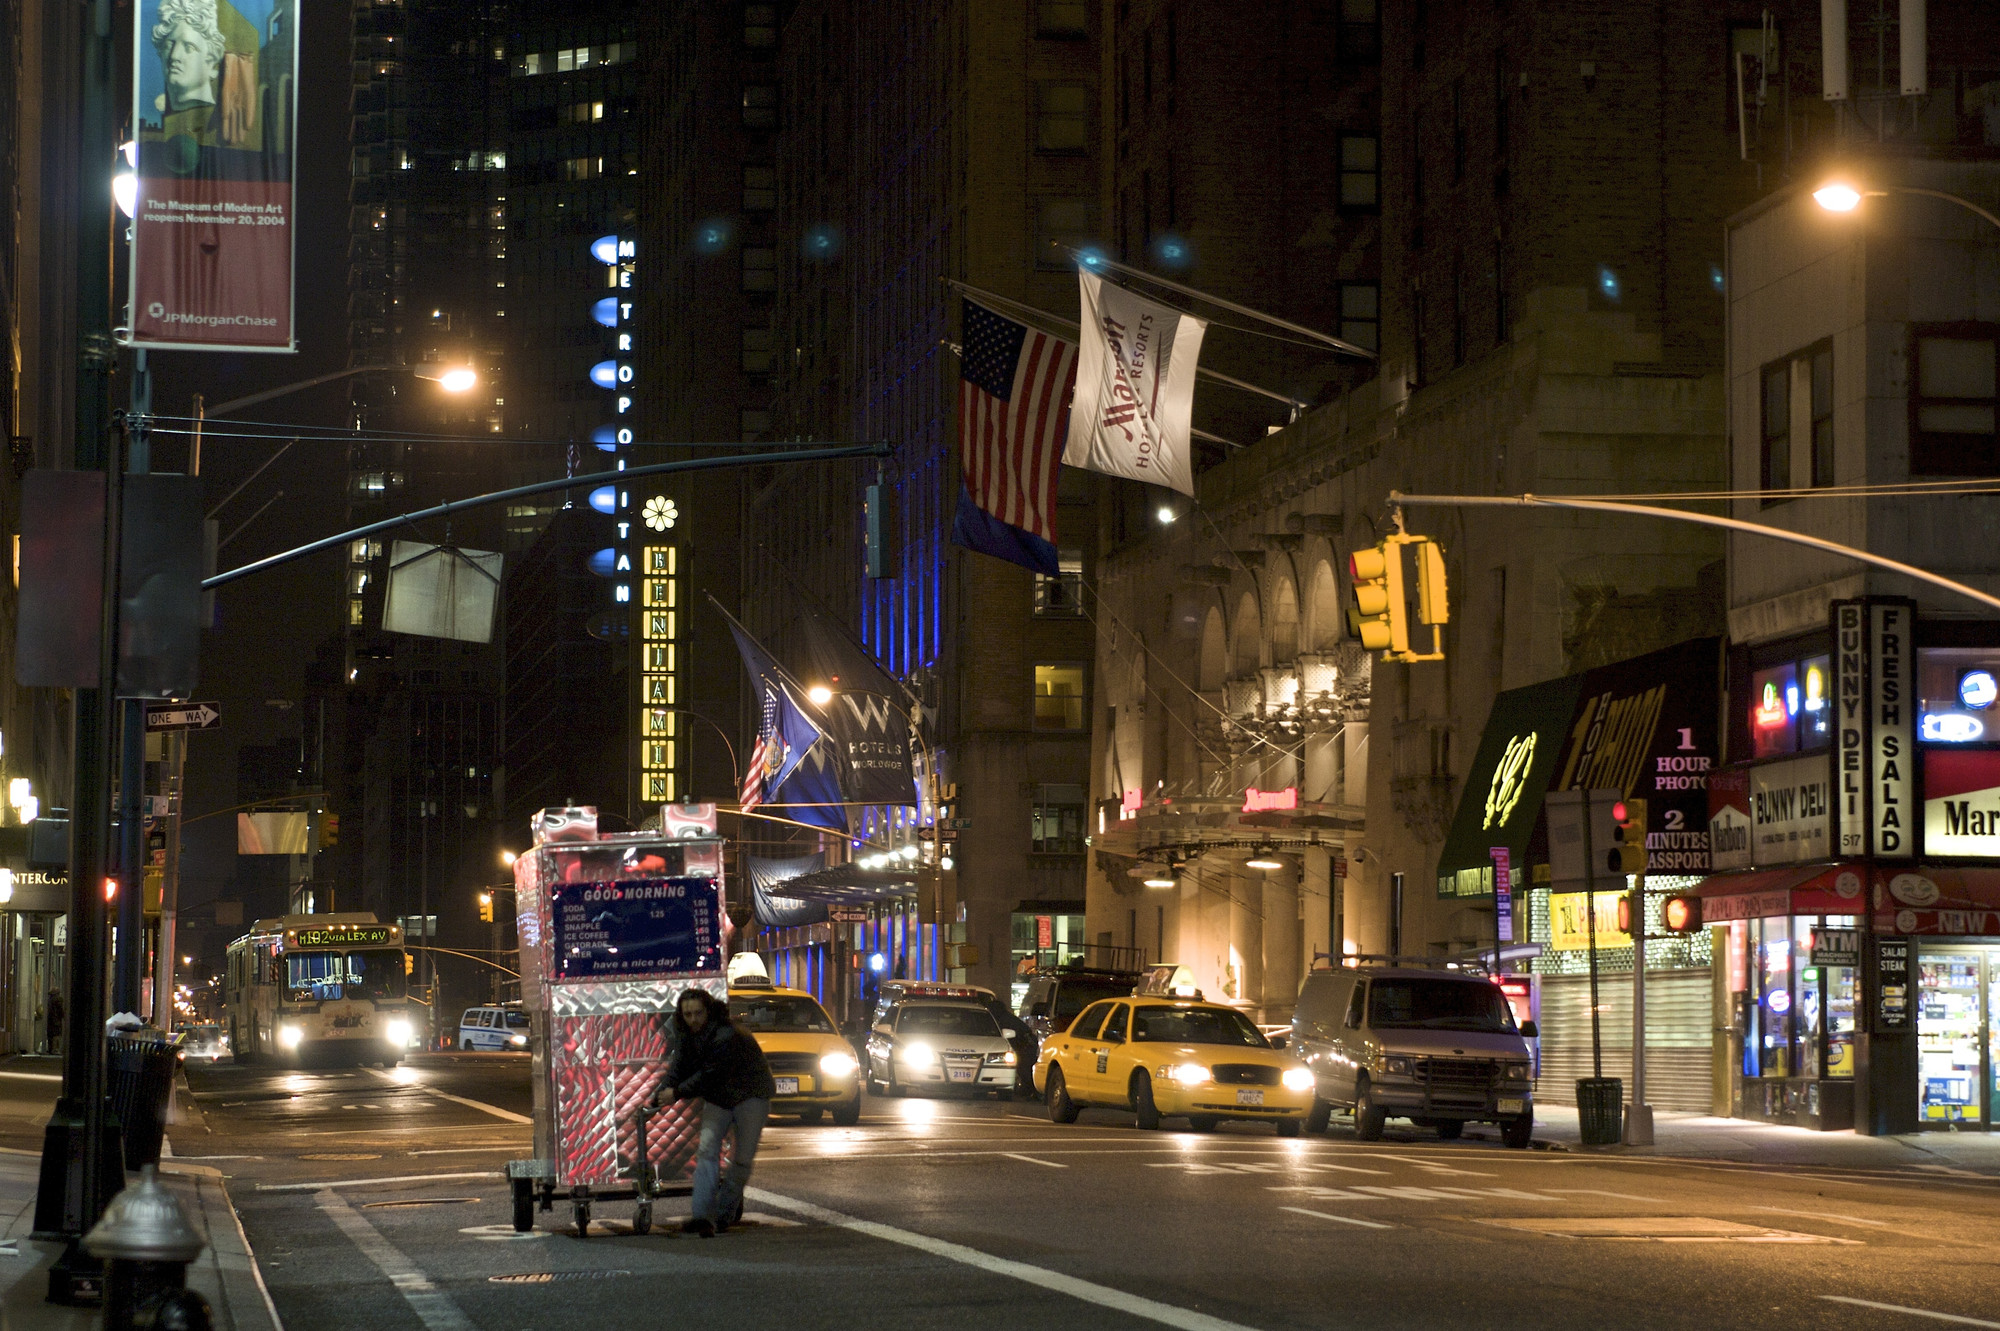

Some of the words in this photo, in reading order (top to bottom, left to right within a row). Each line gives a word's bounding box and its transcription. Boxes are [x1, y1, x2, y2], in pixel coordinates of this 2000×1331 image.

[148, 200, 166, 210] The
[168, 201, 210, 212] Museum
[213, 203, 224, 212] of
[224, 203, 263, 213] Modern
[265, 204, 282, 213] Art
[144, 214, 184, 224] reopens
[186, 214, 236, 224] November
[238, 215, 256, 226] 20,
[257, 216, 286, 226] 2004
[163, 313, 277, 326] JPMorganChase
[1131, 313, 1153, 379] RESORTS
[1102, 315, 1136, 443] Marott
[1841, 609, 1860, 718] BUNNY
[1881, 610, 1900, 725] FRESH
[650, 552, 666, 795] BENJAMIN
[151, 712, 172, 724] ONE
[186, 710, 208, 722] WAY
[841, 694, 891, 734] W
[1676, 728, 1696, 750] 1
[848, 742, 902, 755] HOTELS
[1656, 756, 1711, 772] HOUR
[1842, 730, 1860, 815] DELI
[1881, 735, 1900, 851] SALAD
[1756, 787, 1796, 825] BUNNY
[1800, 782, 1826, 818] DELI
[1664, 810, 1685, 830] 2
[1944, 800, 2000, 836] Mar
[1645, 832, 1710, 850] MINUTES
[1712, 814, 1746, 853] Marlboro
[1842, 834, 1861, 846] 517
[1647, 852, 1710, 870] ASSPORT
[584, 889, 620, 901] GOOD
[625, 886, 686, 900] MORNING
[772, 898, 807, 910] BLUE
[564, 914, 586, 922] JUICE
[650, 910, 665, 918] 1.25
[694, 908, 708, 916] 1.50
[1578, 906, 1620, 933] POTO
[1938, 910, 1987, 933] NEW
[564, 922, 600, 931] SNAPPLE
[348, 932, 368, 940] LEX
[372, 931, 386, 940] AV
[564, 932, 577, 940] ICE
[578, 932, 610, 940] COFFEE
[564, 941, 608, 950] GATORADE
[696, 936, 710, 944] 1.50
[1813, 932, 1858, 952] ATM
[564, 950, 592, 958] WATER
[1881, 947, 1907, 957] SALAD
[593, 960, 619, 968] have
[632, 960, 654, 968] nice
[657, 957, 680, 968] day!
[1880, 960, 1906, 971] STEAK
